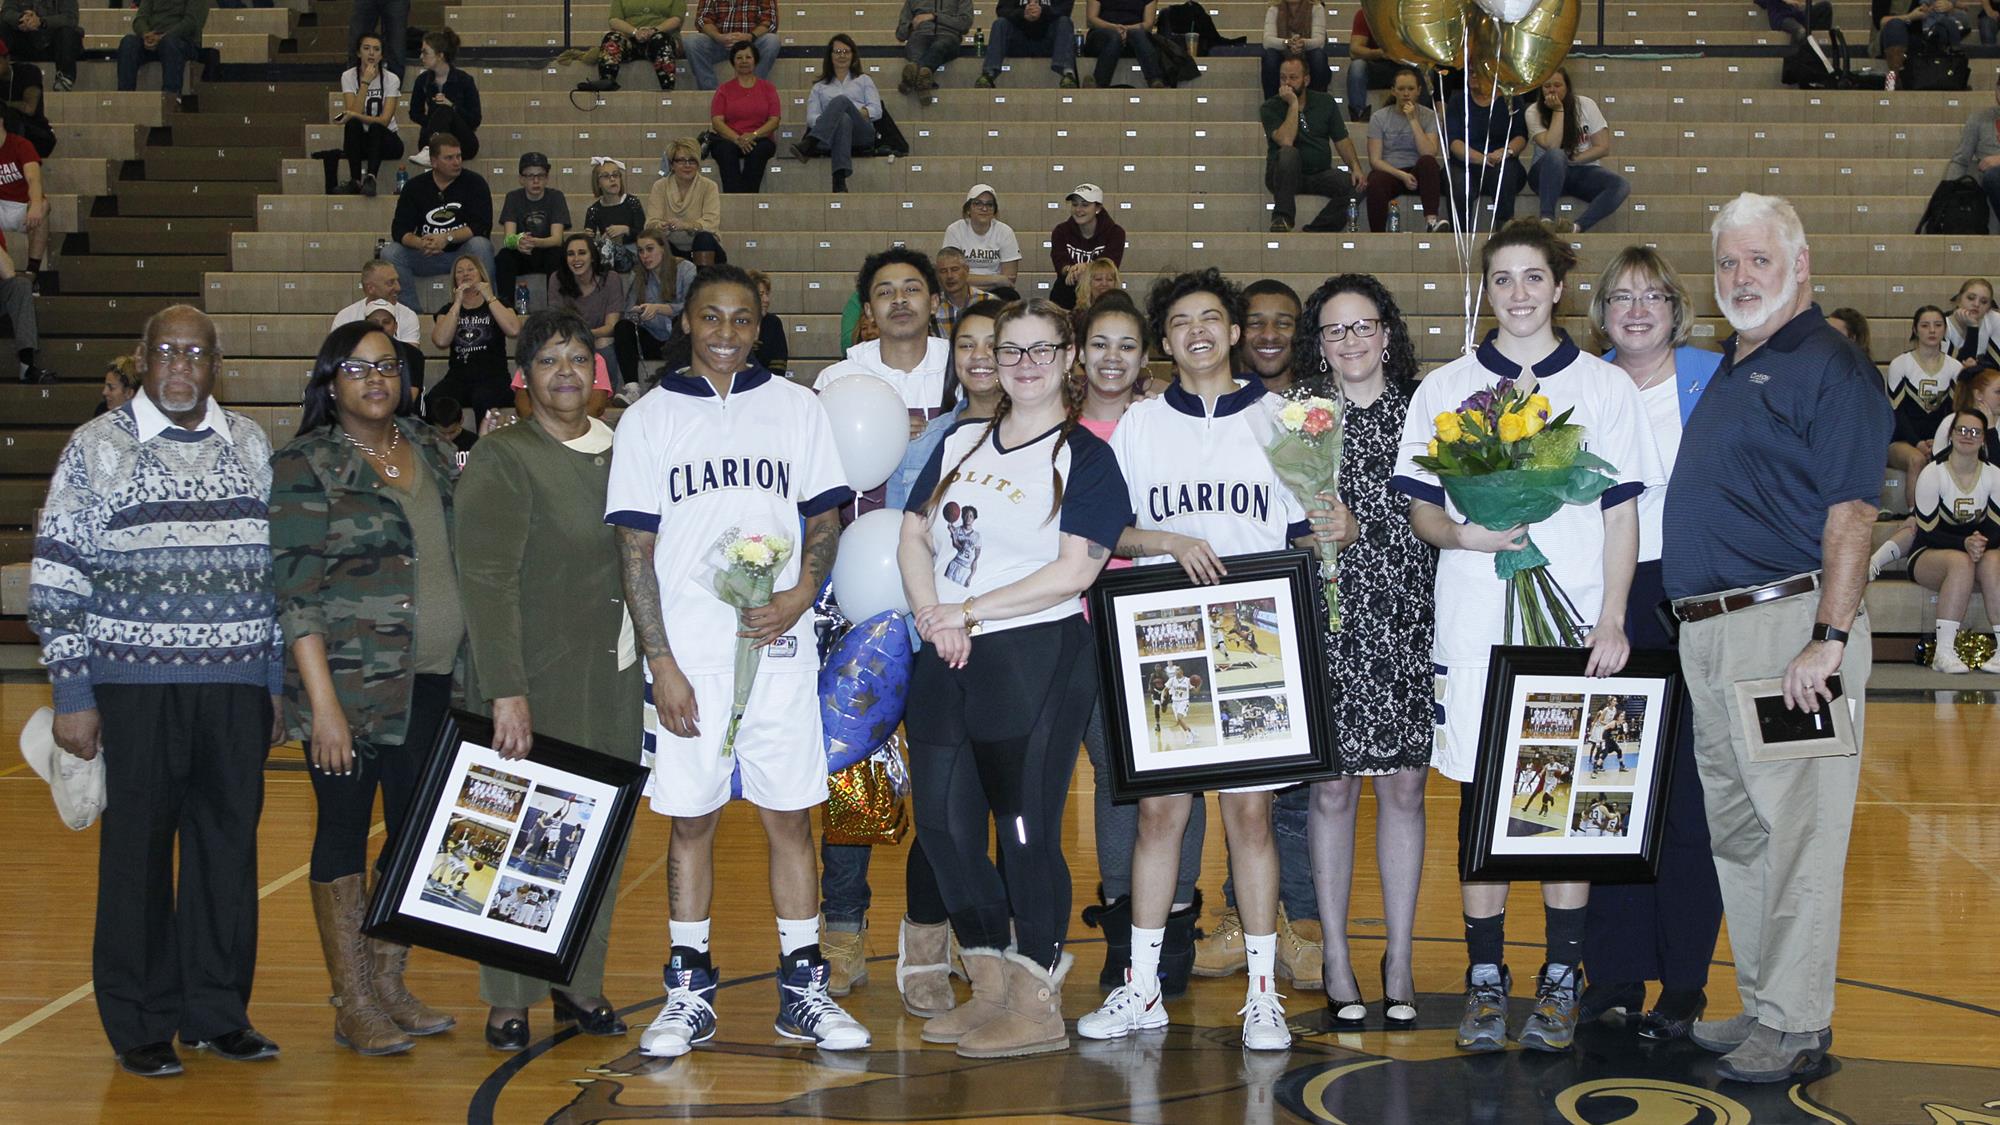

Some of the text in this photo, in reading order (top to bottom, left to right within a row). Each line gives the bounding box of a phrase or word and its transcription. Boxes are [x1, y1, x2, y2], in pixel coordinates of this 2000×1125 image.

[961, 248, 1001, 259] LARION
[109, 299, 117, 307] G
[42, 389, 49, 397] E
[6, 437, 14, 446] D
[669, 458, 790, 504] CLARION
[1149, 482, 1269, 522] CLARION
